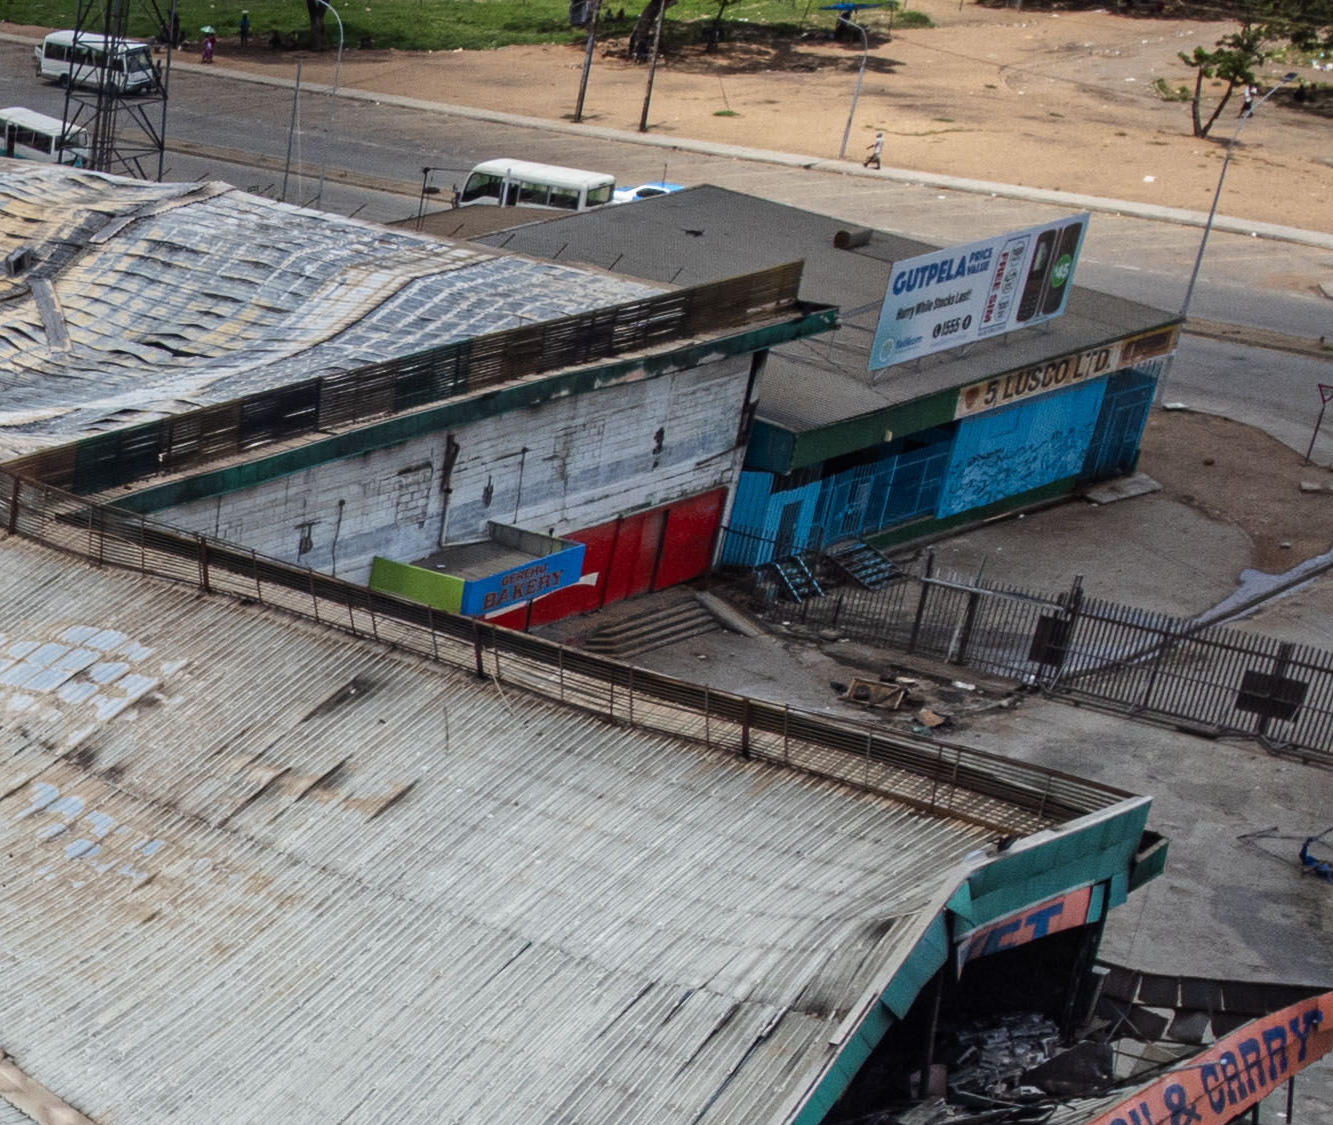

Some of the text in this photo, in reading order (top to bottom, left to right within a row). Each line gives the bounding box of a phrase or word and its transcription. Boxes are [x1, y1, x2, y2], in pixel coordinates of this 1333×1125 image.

[892, 255, 966, 296] GUTPELA
[968, 246, 993, 264] PRICE
[1002, 358, 1069, 400] LUSCO
[483, 569, 564, 610] BAKERY
[501, 562, 548, 586] GEREHU
[1200, 1009, 1324, 1115] CARRY
